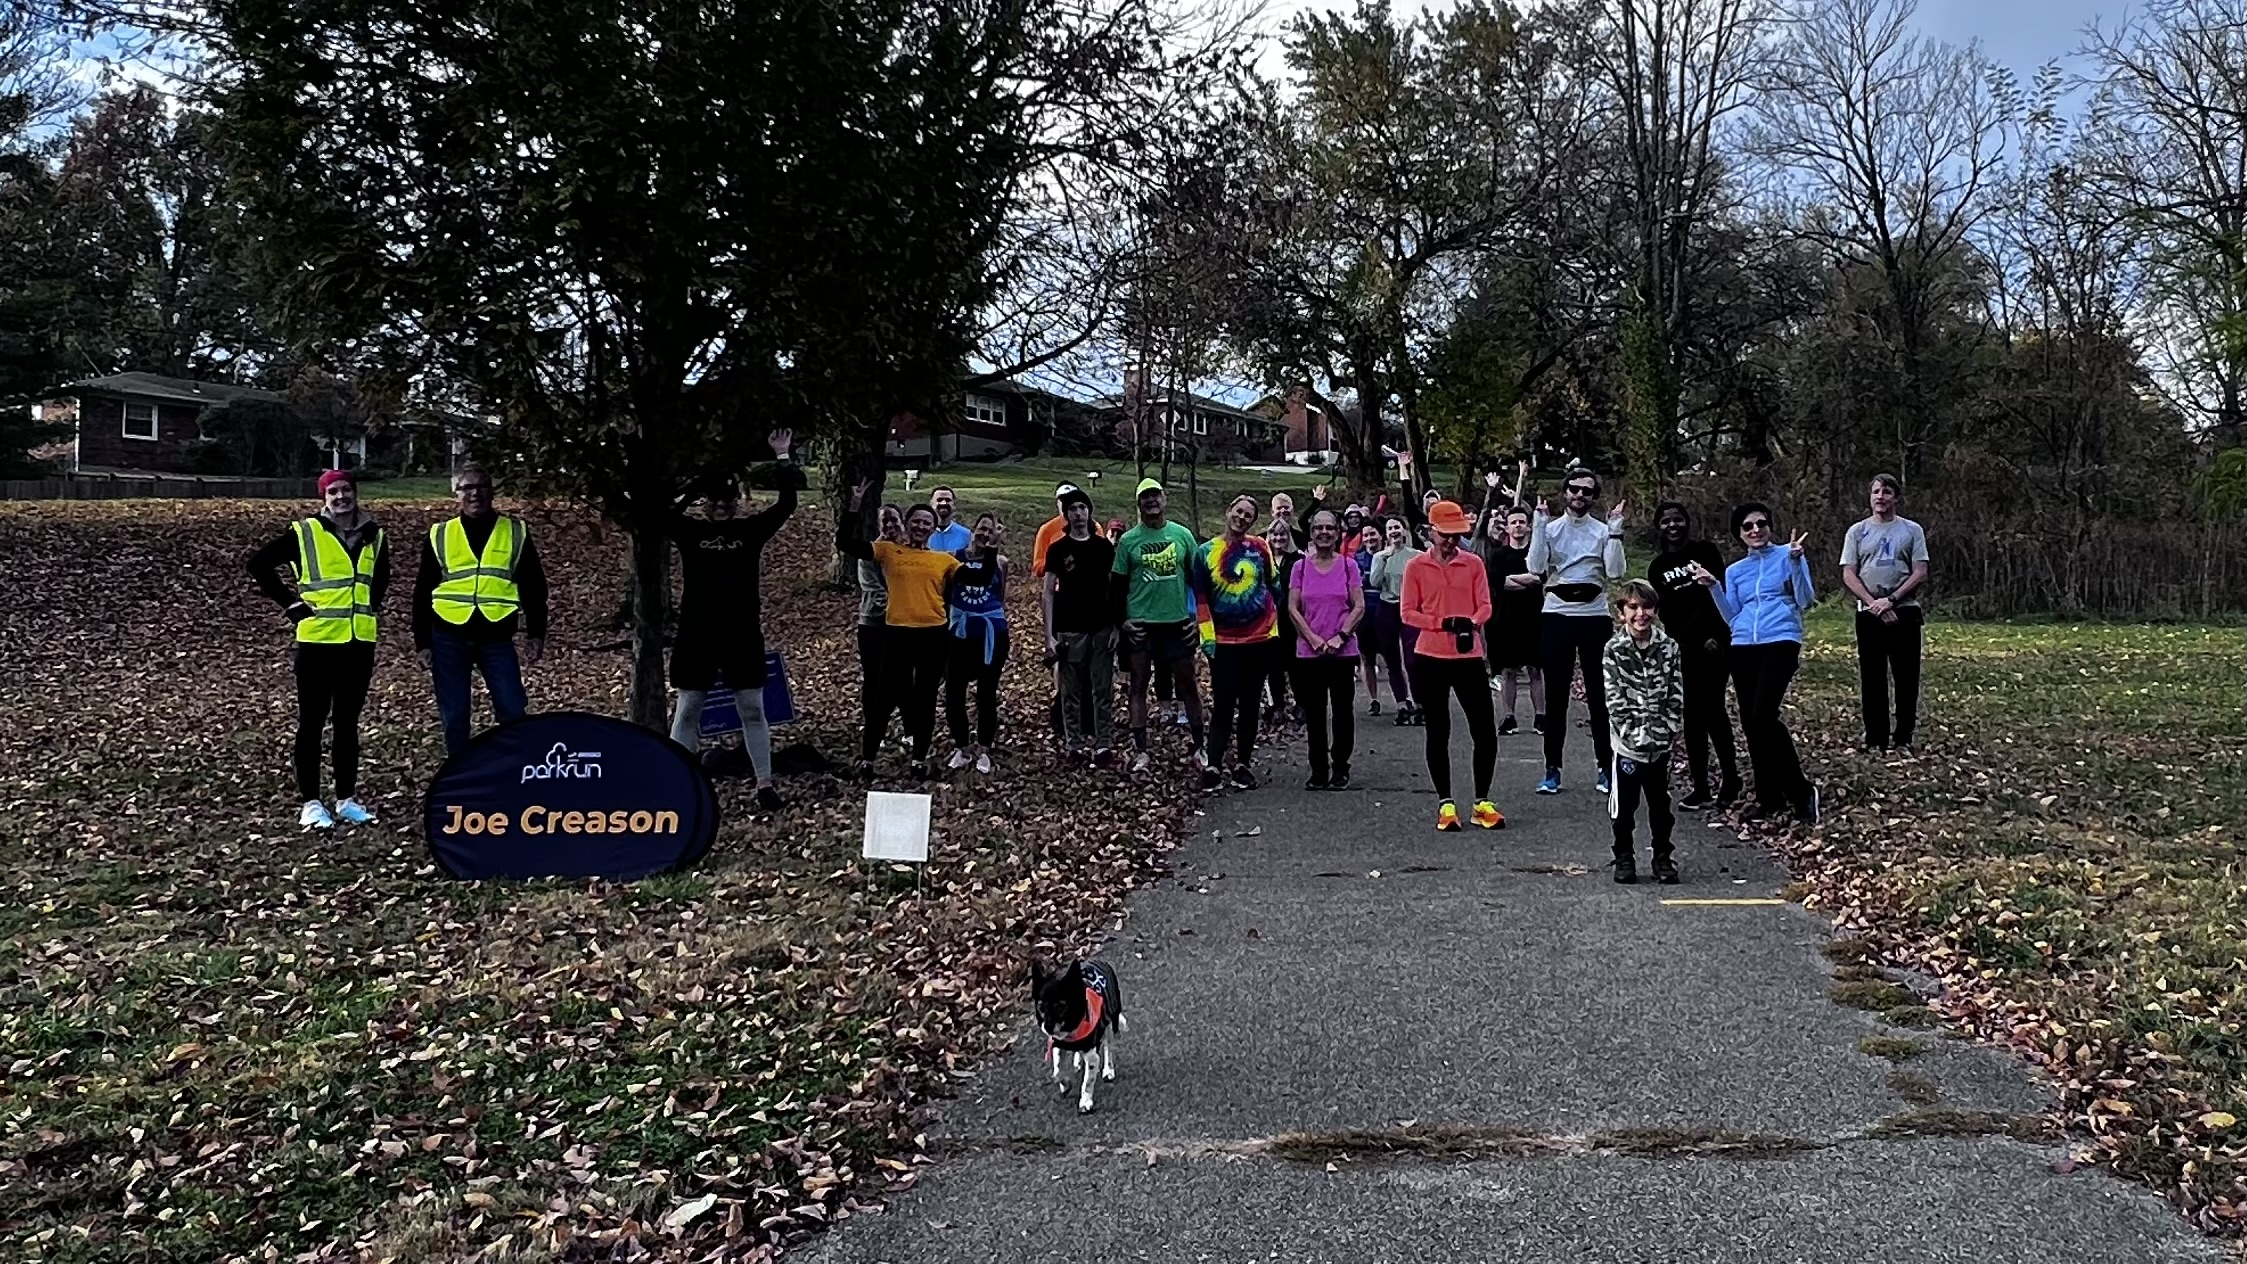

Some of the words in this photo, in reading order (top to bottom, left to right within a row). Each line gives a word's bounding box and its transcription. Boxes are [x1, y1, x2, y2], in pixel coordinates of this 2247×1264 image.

[521, 754, 602, 785] parkrun
[443, 806, 508, 834] Joe
[521, 806, 678, 834] Creason
